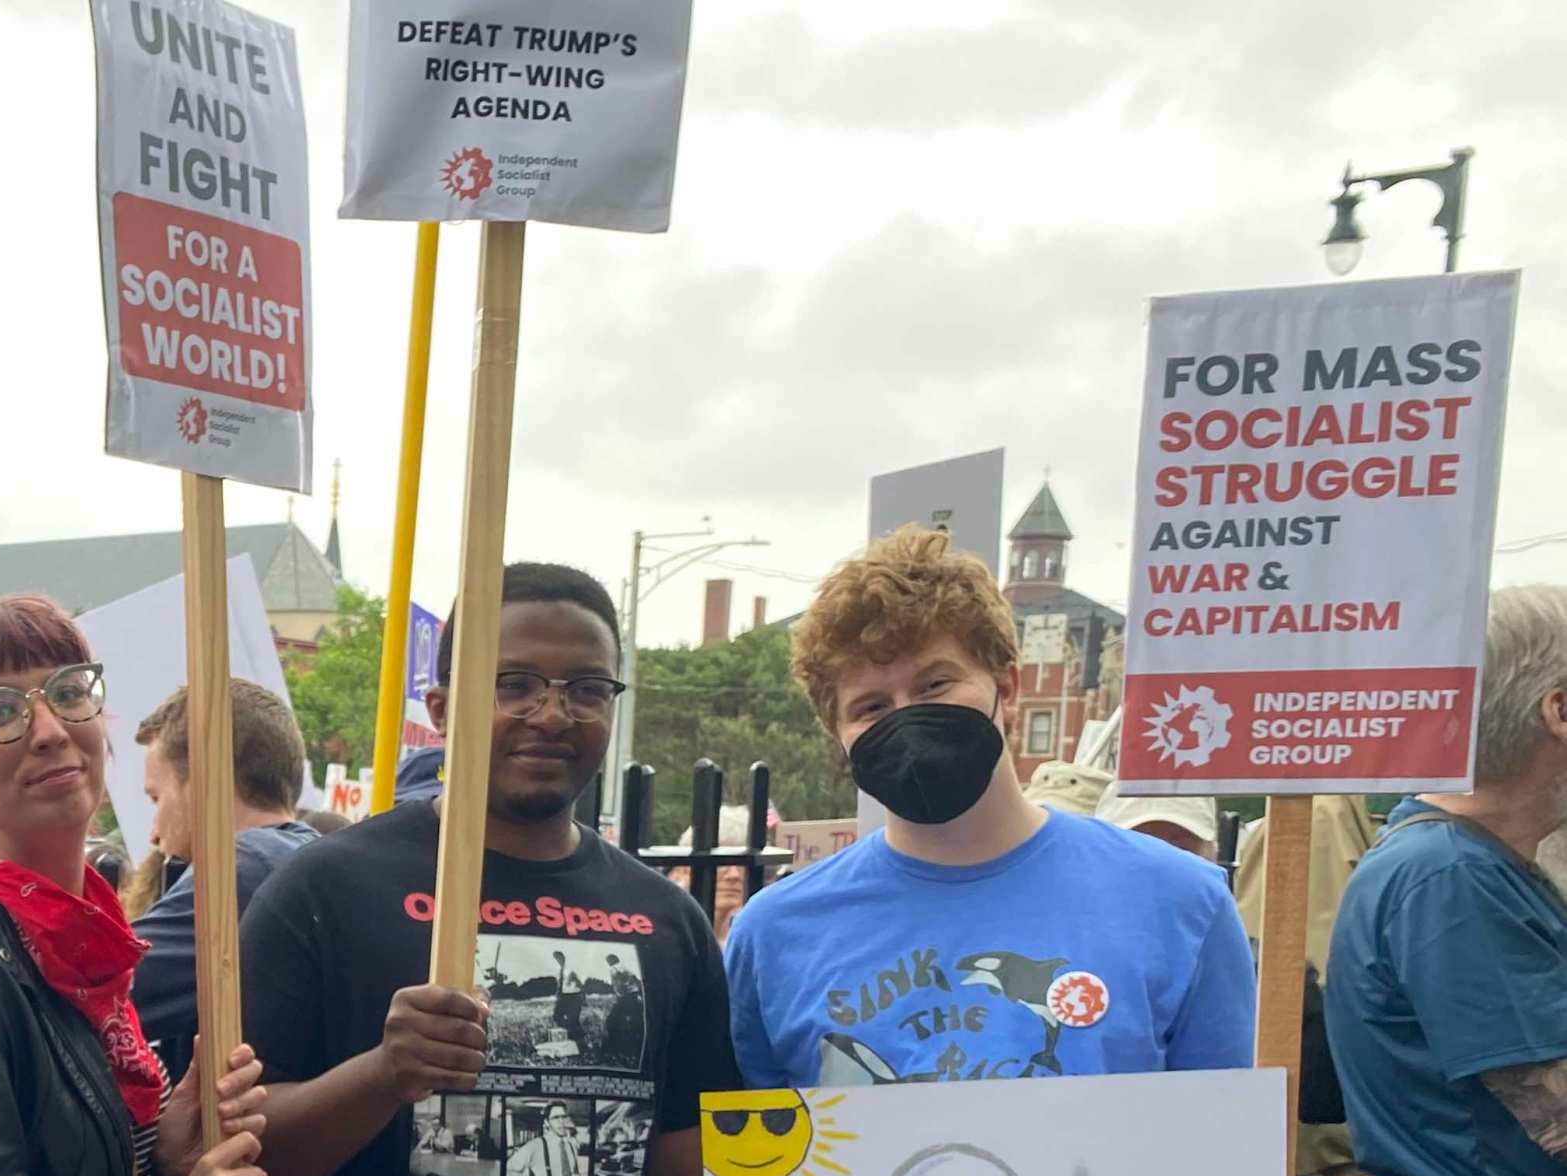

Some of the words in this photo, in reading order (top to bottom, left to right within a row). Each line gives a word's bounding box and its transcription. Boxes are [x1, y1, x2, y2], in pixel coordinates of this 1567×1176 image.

[132, 4, 271, 95] UNITE
[398, 21, 502, 48] DEFEAT
[513, 26, 638, 57] TRUMP'S
[424, 58, 605, 90] RIGHT-WING
[168, 87, 247, 144] AND
[450, 96, 572, 123] AGENDA
[139, 131, 277, 221] FIGHT
[497, 169, 551, 181] Socialist
[498, 153, 578, 169] Independent
[496, 185, 536, 199] Group
[167, 225, 228, 274] FOR
[237, 244, 258, 283] A
[120, 264, 301, 345] SOCIALIST
[141, 322, 287, 394] WORLD!
[1162, 353, 1280, 398] FOR
[1302, 340, 1482, 392] MASS
[1159, 397, 1472, 452] SOCIALIST
[1154, 454, 1460, 507] STRUGGLE
[1149, 516, 1341, 551] AGAINST
[1147, 563, 1249, 594] WAR
[1258, 561, 1289, 590] &
[1143, 601, 1401, 636] CAPITALISM
[1253, 689, 1459, 713] INDEPENDENT
[1250, 717, 1406, 738] SOCIALIST
[1249, 744, 1353, 765] GROUP
[403, 892, 531, 925] Oce
[535, 896, 654, 936] Space
[827, 949, 952, 1026] SINK
[898, 1004, 989, 1040] THE
